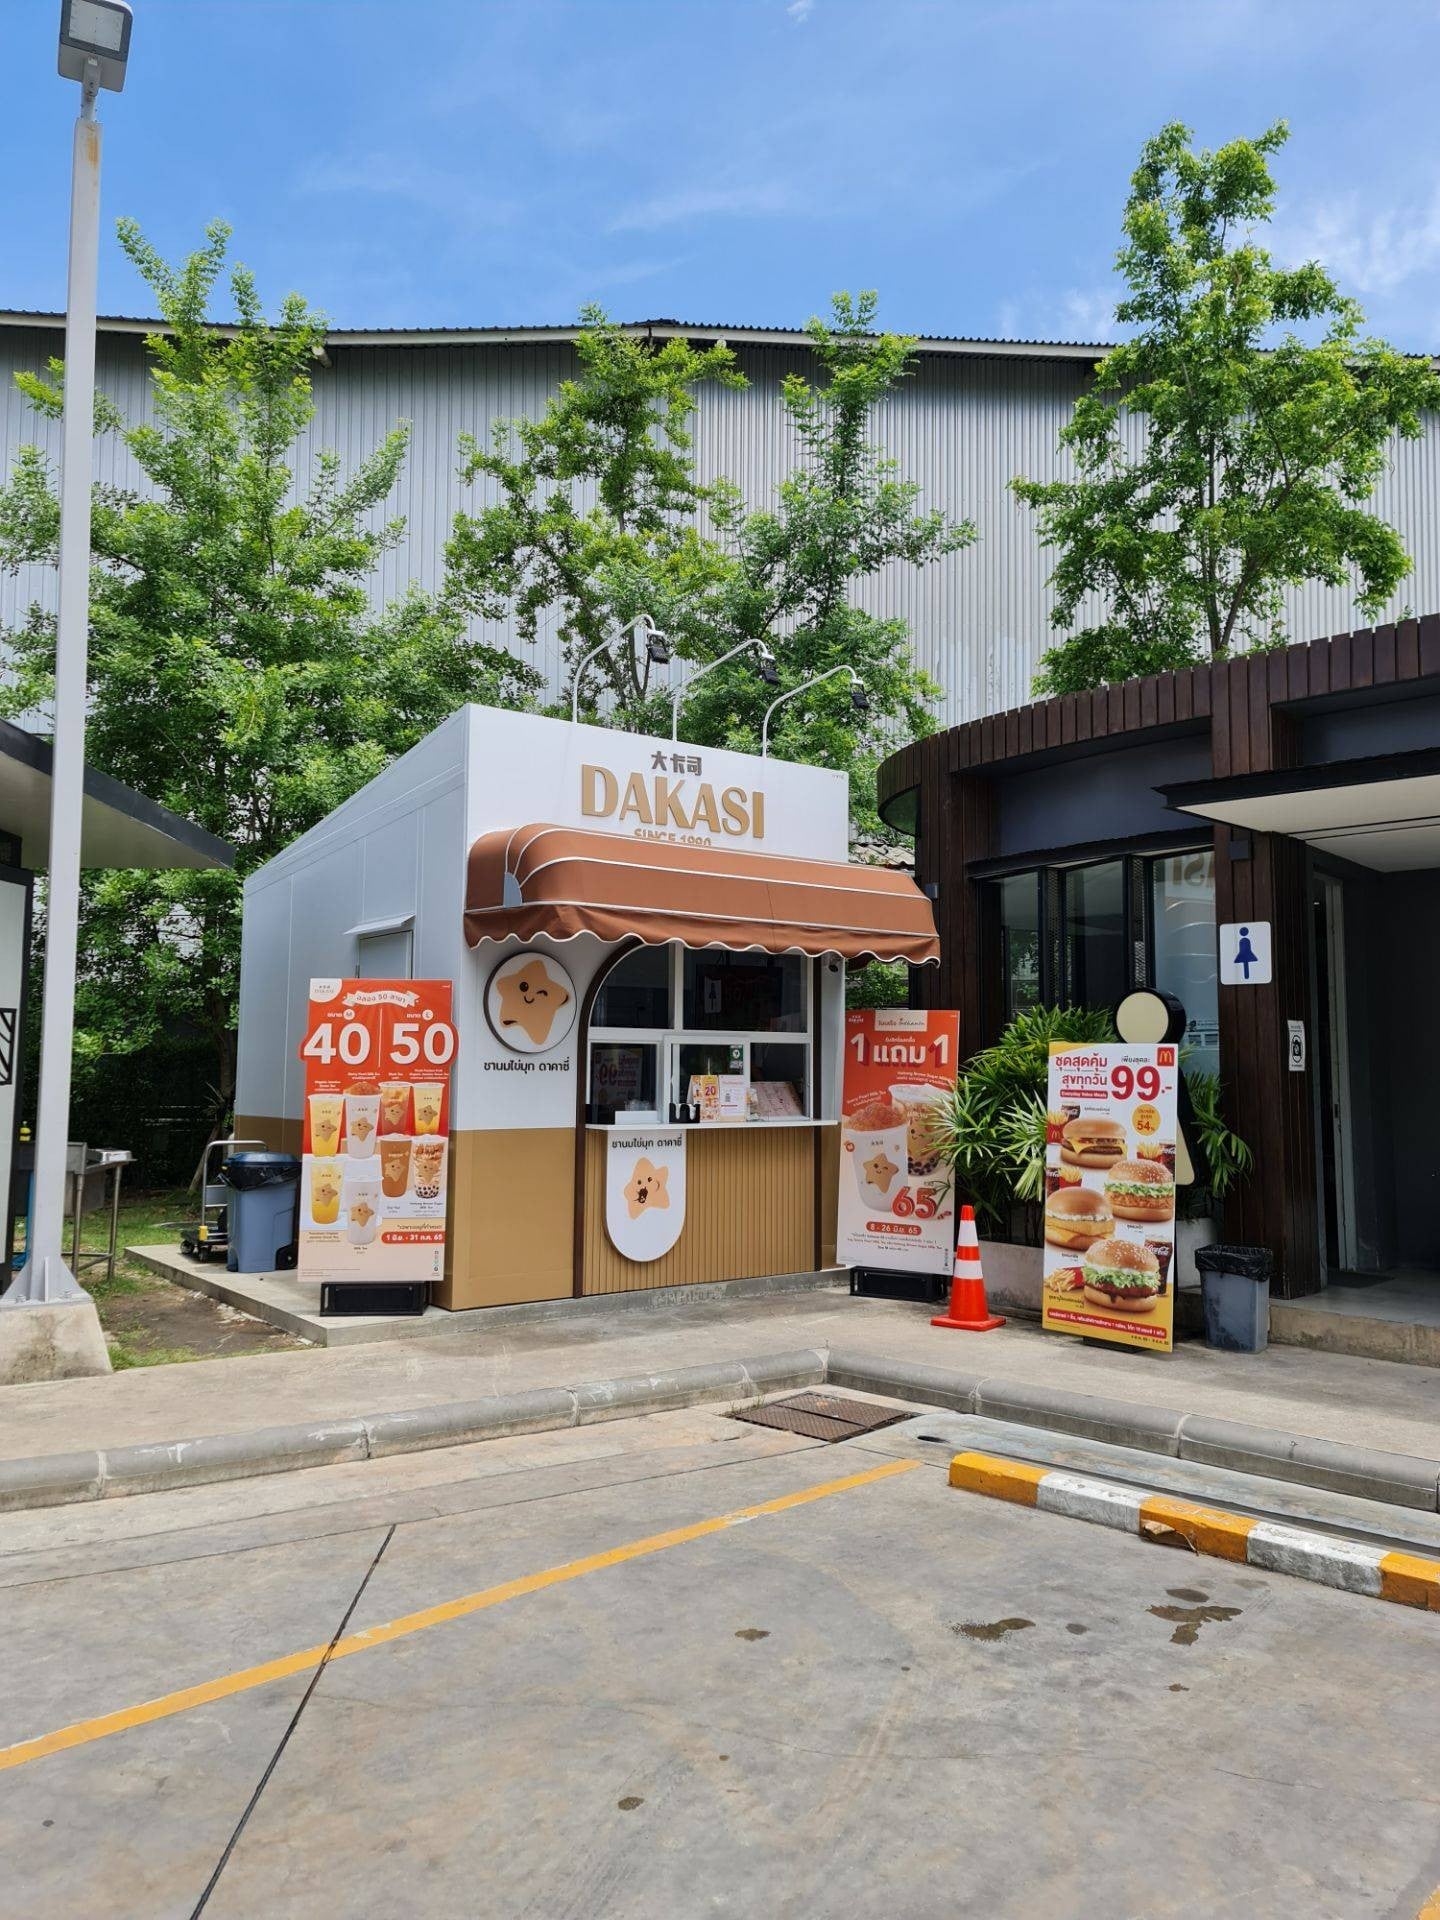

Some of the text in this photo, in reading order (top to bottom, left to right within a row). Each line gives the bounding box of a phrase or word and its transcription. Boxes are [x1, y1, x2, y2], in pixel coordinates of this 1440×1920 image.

[651, 751, 703, 777] 大卡司
[581, 764, 765, 839] DAKASI
[303, 1023, 371, 1065] 40
[389, 1022, 455, 1065] 50
[850, 1033, 949, 1065] 1 แถม 1
[483, 1059, 535, 1075] ชานมไข่มุก
[1055, 1053, 1108, 1072] ชุดสุดคุ้ม
[1062, 1073, 1107, 1089] สุขทุกวัน
[612, 1137, 654, 1150] ชานมไข่มุก
[410, 1233, 418, 1241] 31
[881, 1224, 891, 1232] 26
[908, 1226, 918, 1234] 65
